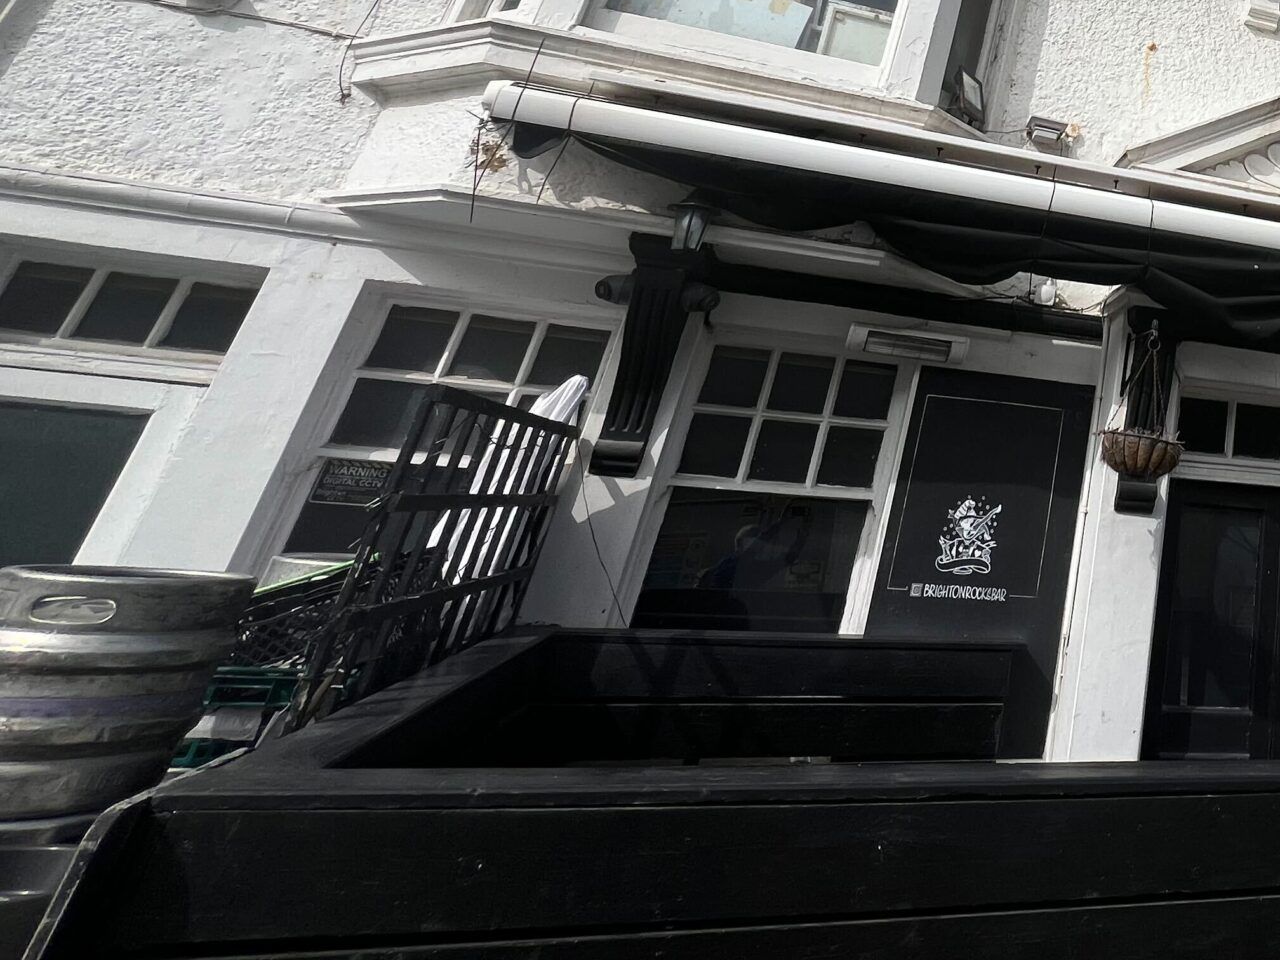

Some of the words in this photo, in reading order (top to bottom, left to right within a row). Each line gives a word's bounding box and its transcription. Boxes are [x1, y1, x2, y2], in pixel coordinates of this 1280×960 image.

[329, 465, 388, 478] WARNING
[323, 477, 357, 486] DIGITAL
[359, 479, 384, 487] CCTV
[923, 584, 1007, 601] BRIGHTONROCKSBAR
